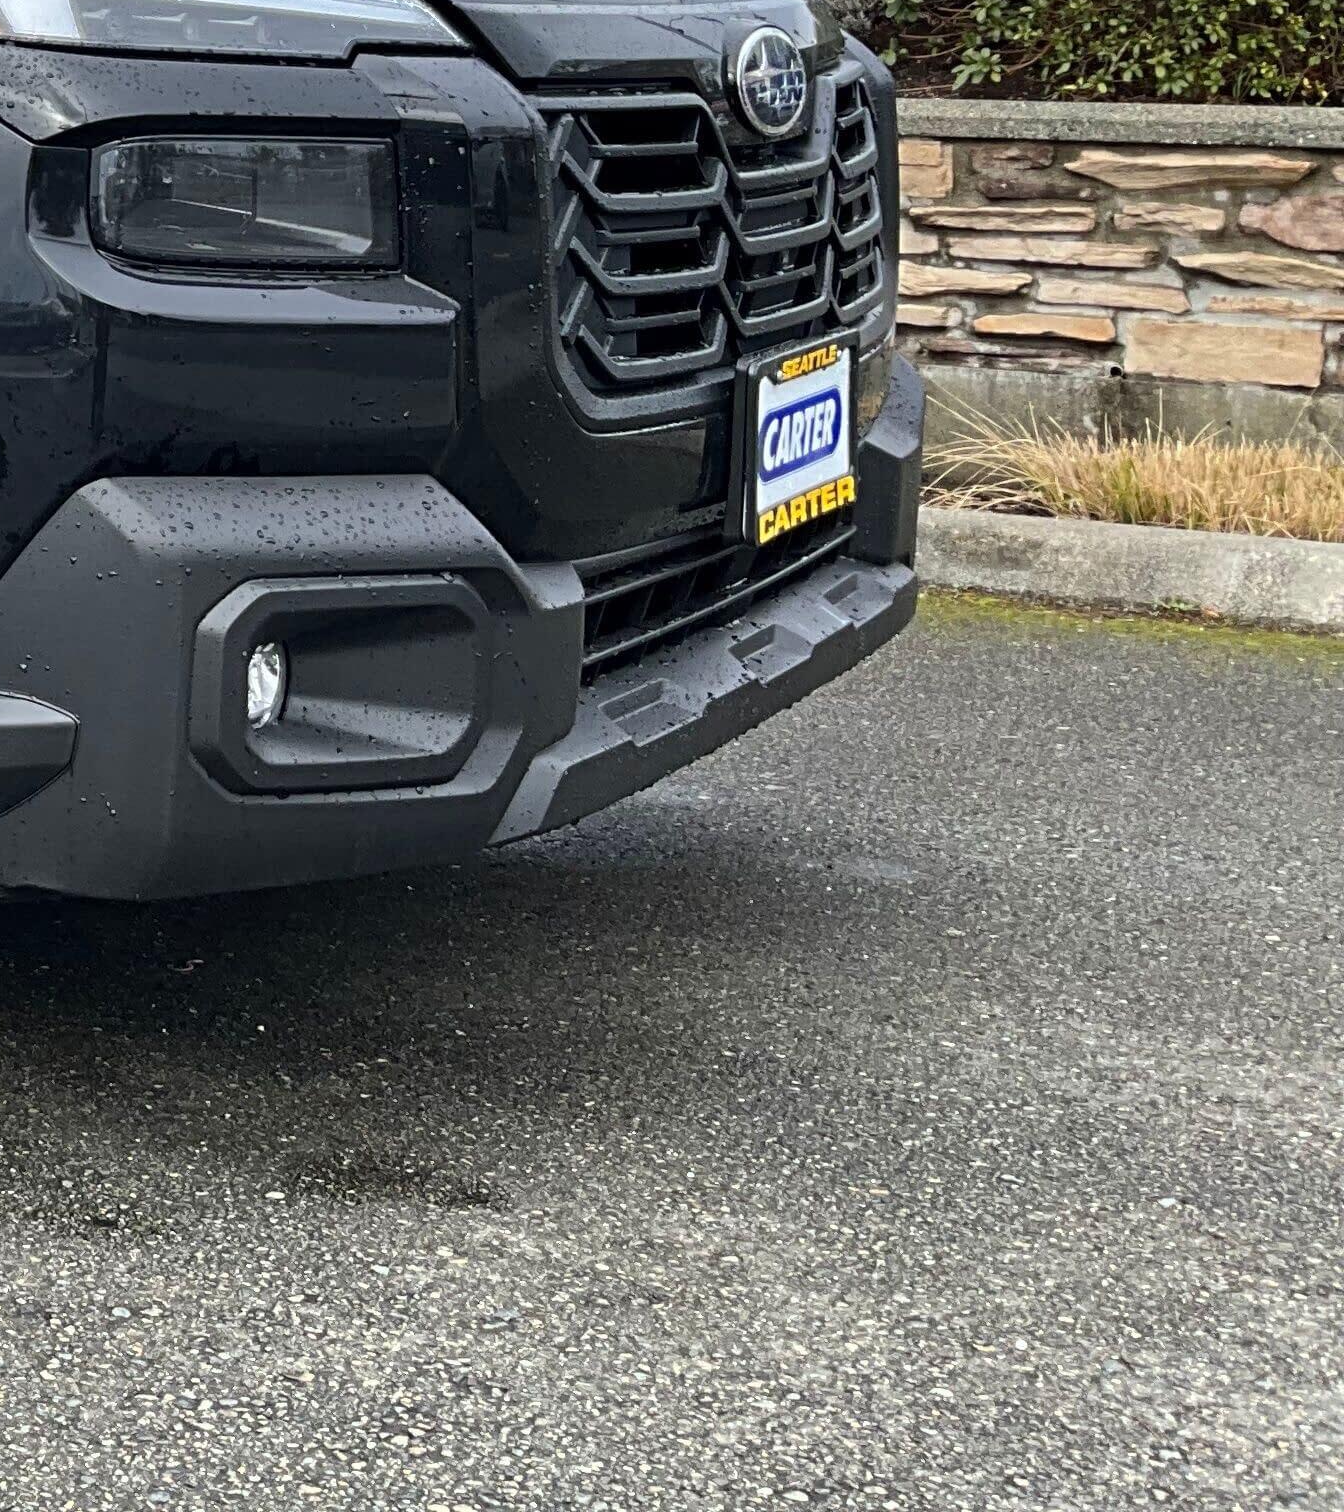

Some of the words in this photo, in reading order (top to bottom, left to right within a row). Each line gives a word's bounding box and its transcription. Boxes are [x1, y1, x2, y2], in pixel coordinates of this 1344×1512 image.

[781, 344, 838, 380] SEATTLE
[763, 397, 837, 472] CARTER
[758, 474, 857, 545] CARTER
